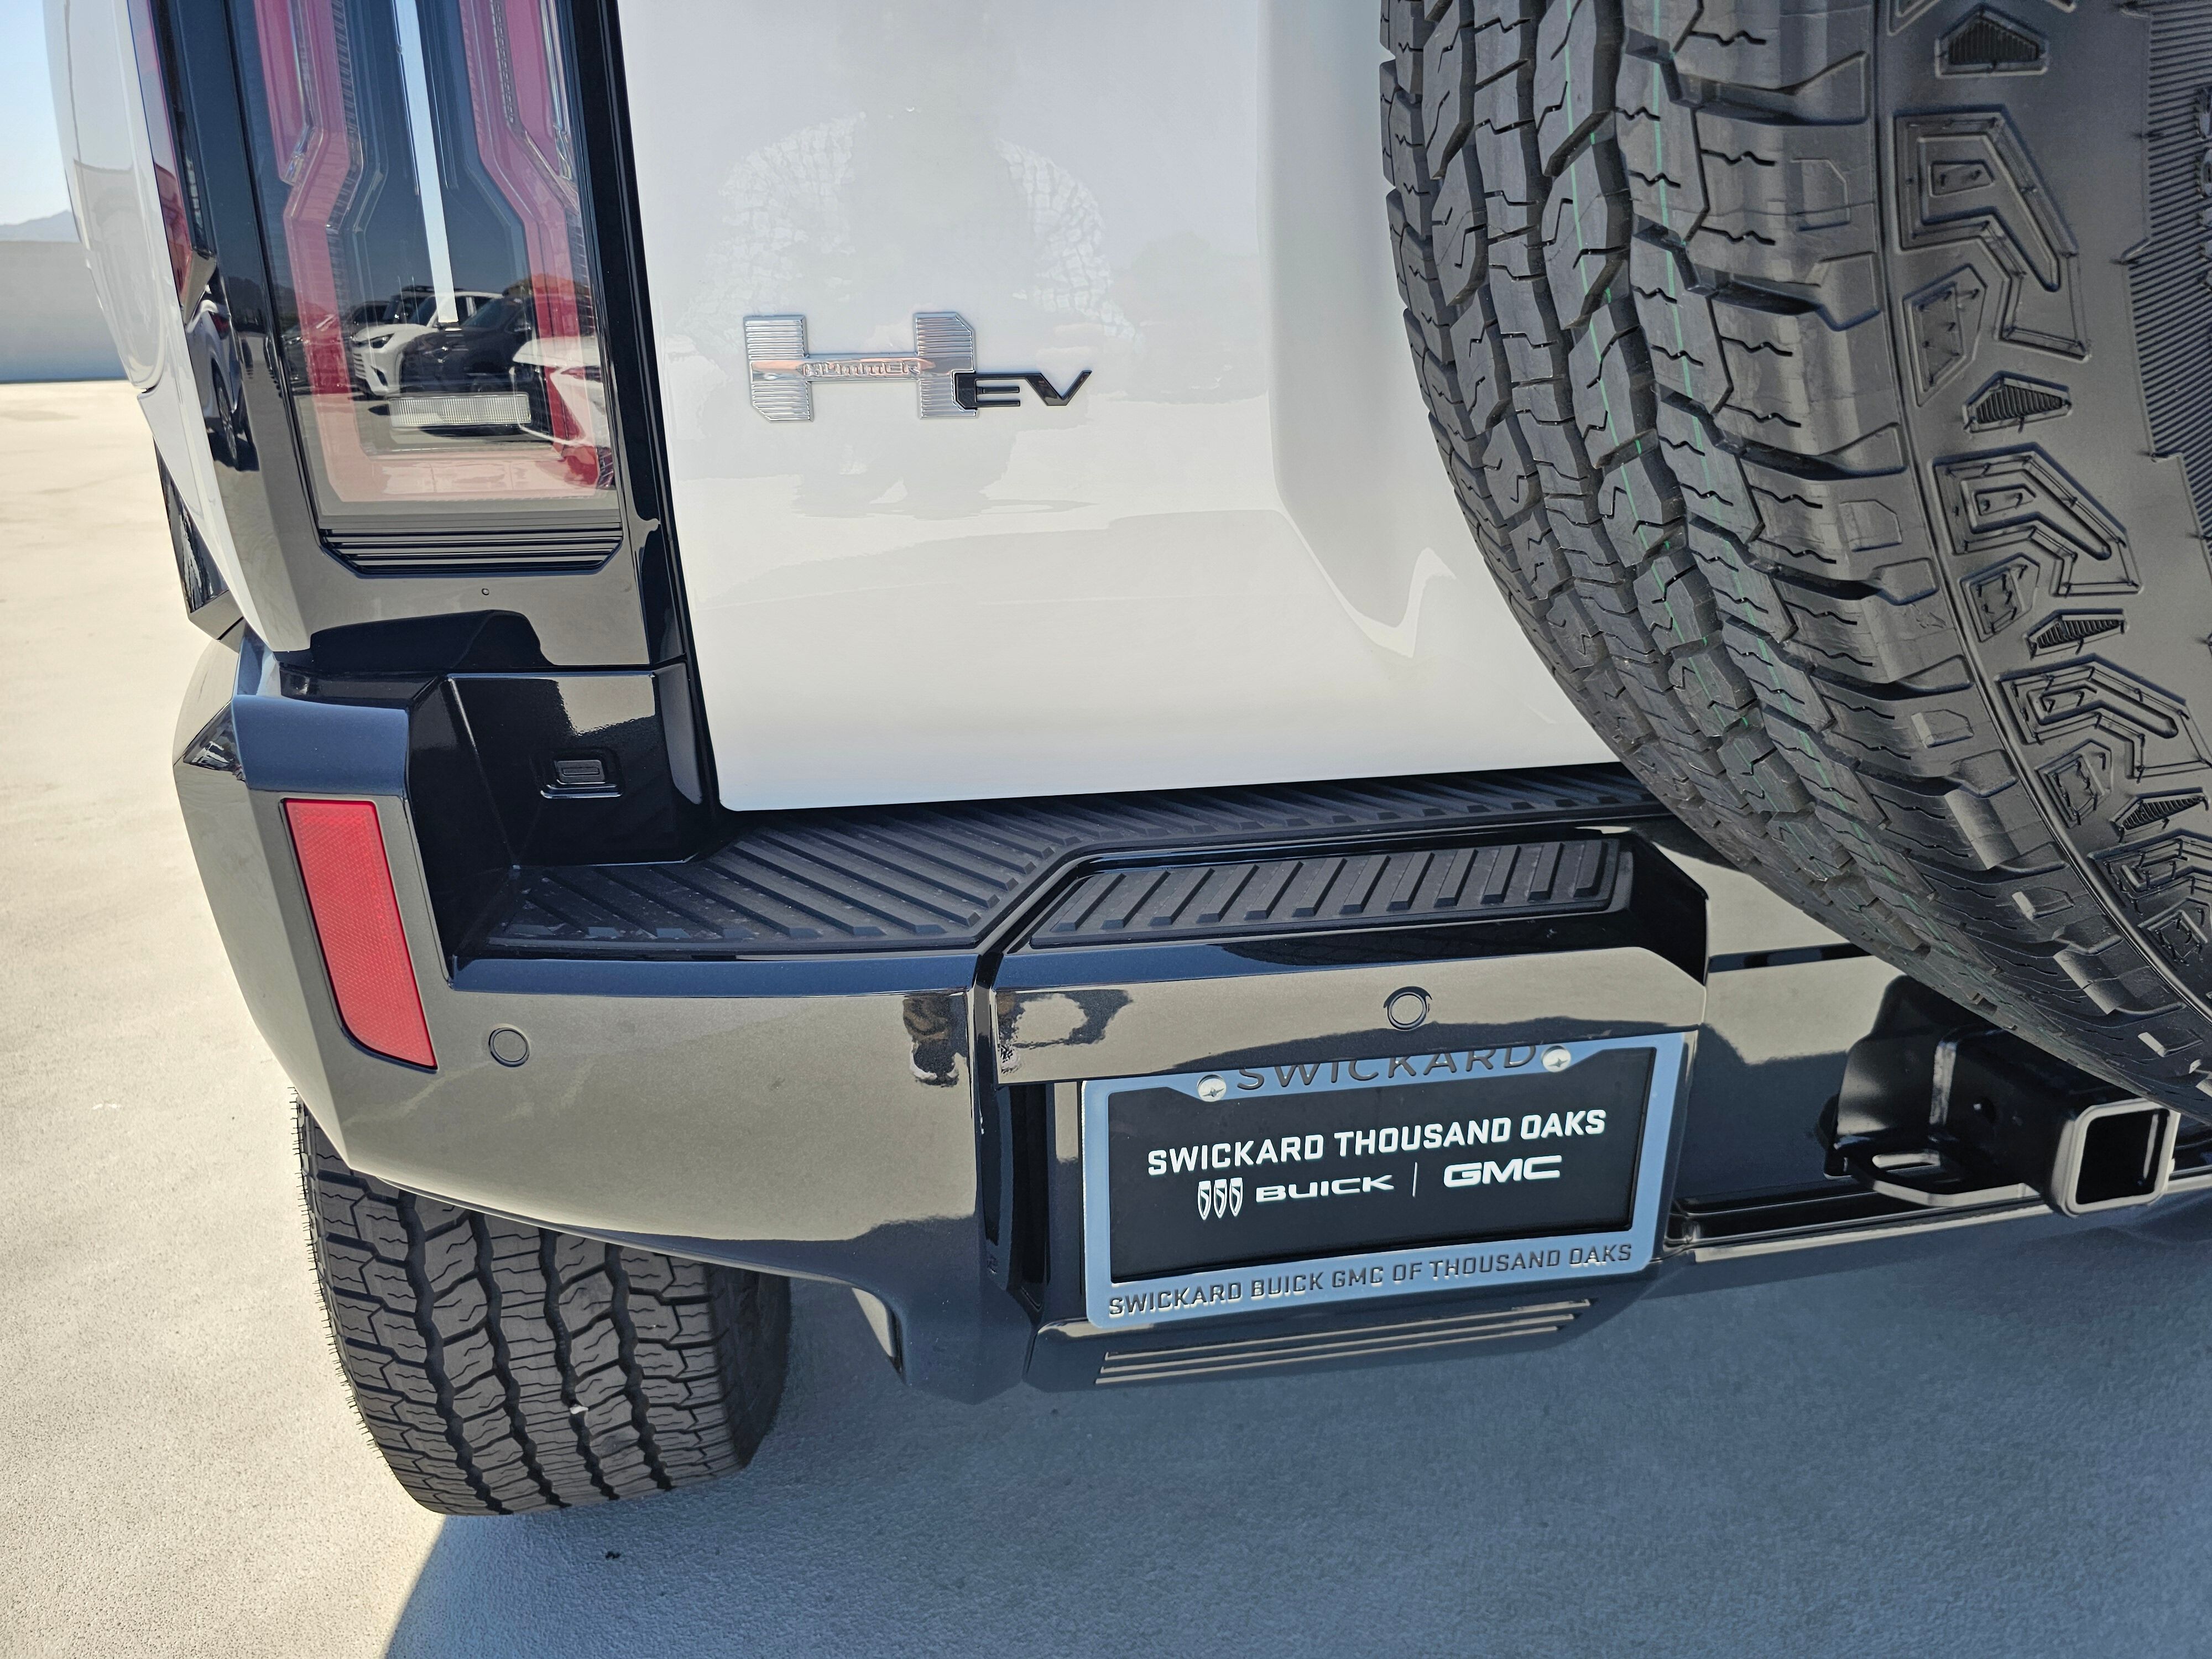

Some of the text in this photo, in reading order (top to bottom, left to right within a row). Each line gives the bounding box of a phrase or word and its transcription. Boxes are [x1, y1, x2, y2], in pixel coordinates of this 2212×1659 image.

[803, 361, 921, 377] HUMMER
[954, 370, 1092, 410] EV
[1147, 1109, 1606, 1176] SWICKARD THOUSAND OAKS
[1256, 1155, 1562, 1203] BUICK GMC
[1109, 1243, 1632, 1317] SWICKARD BUICK GMC OF THOUSAND OAKS
